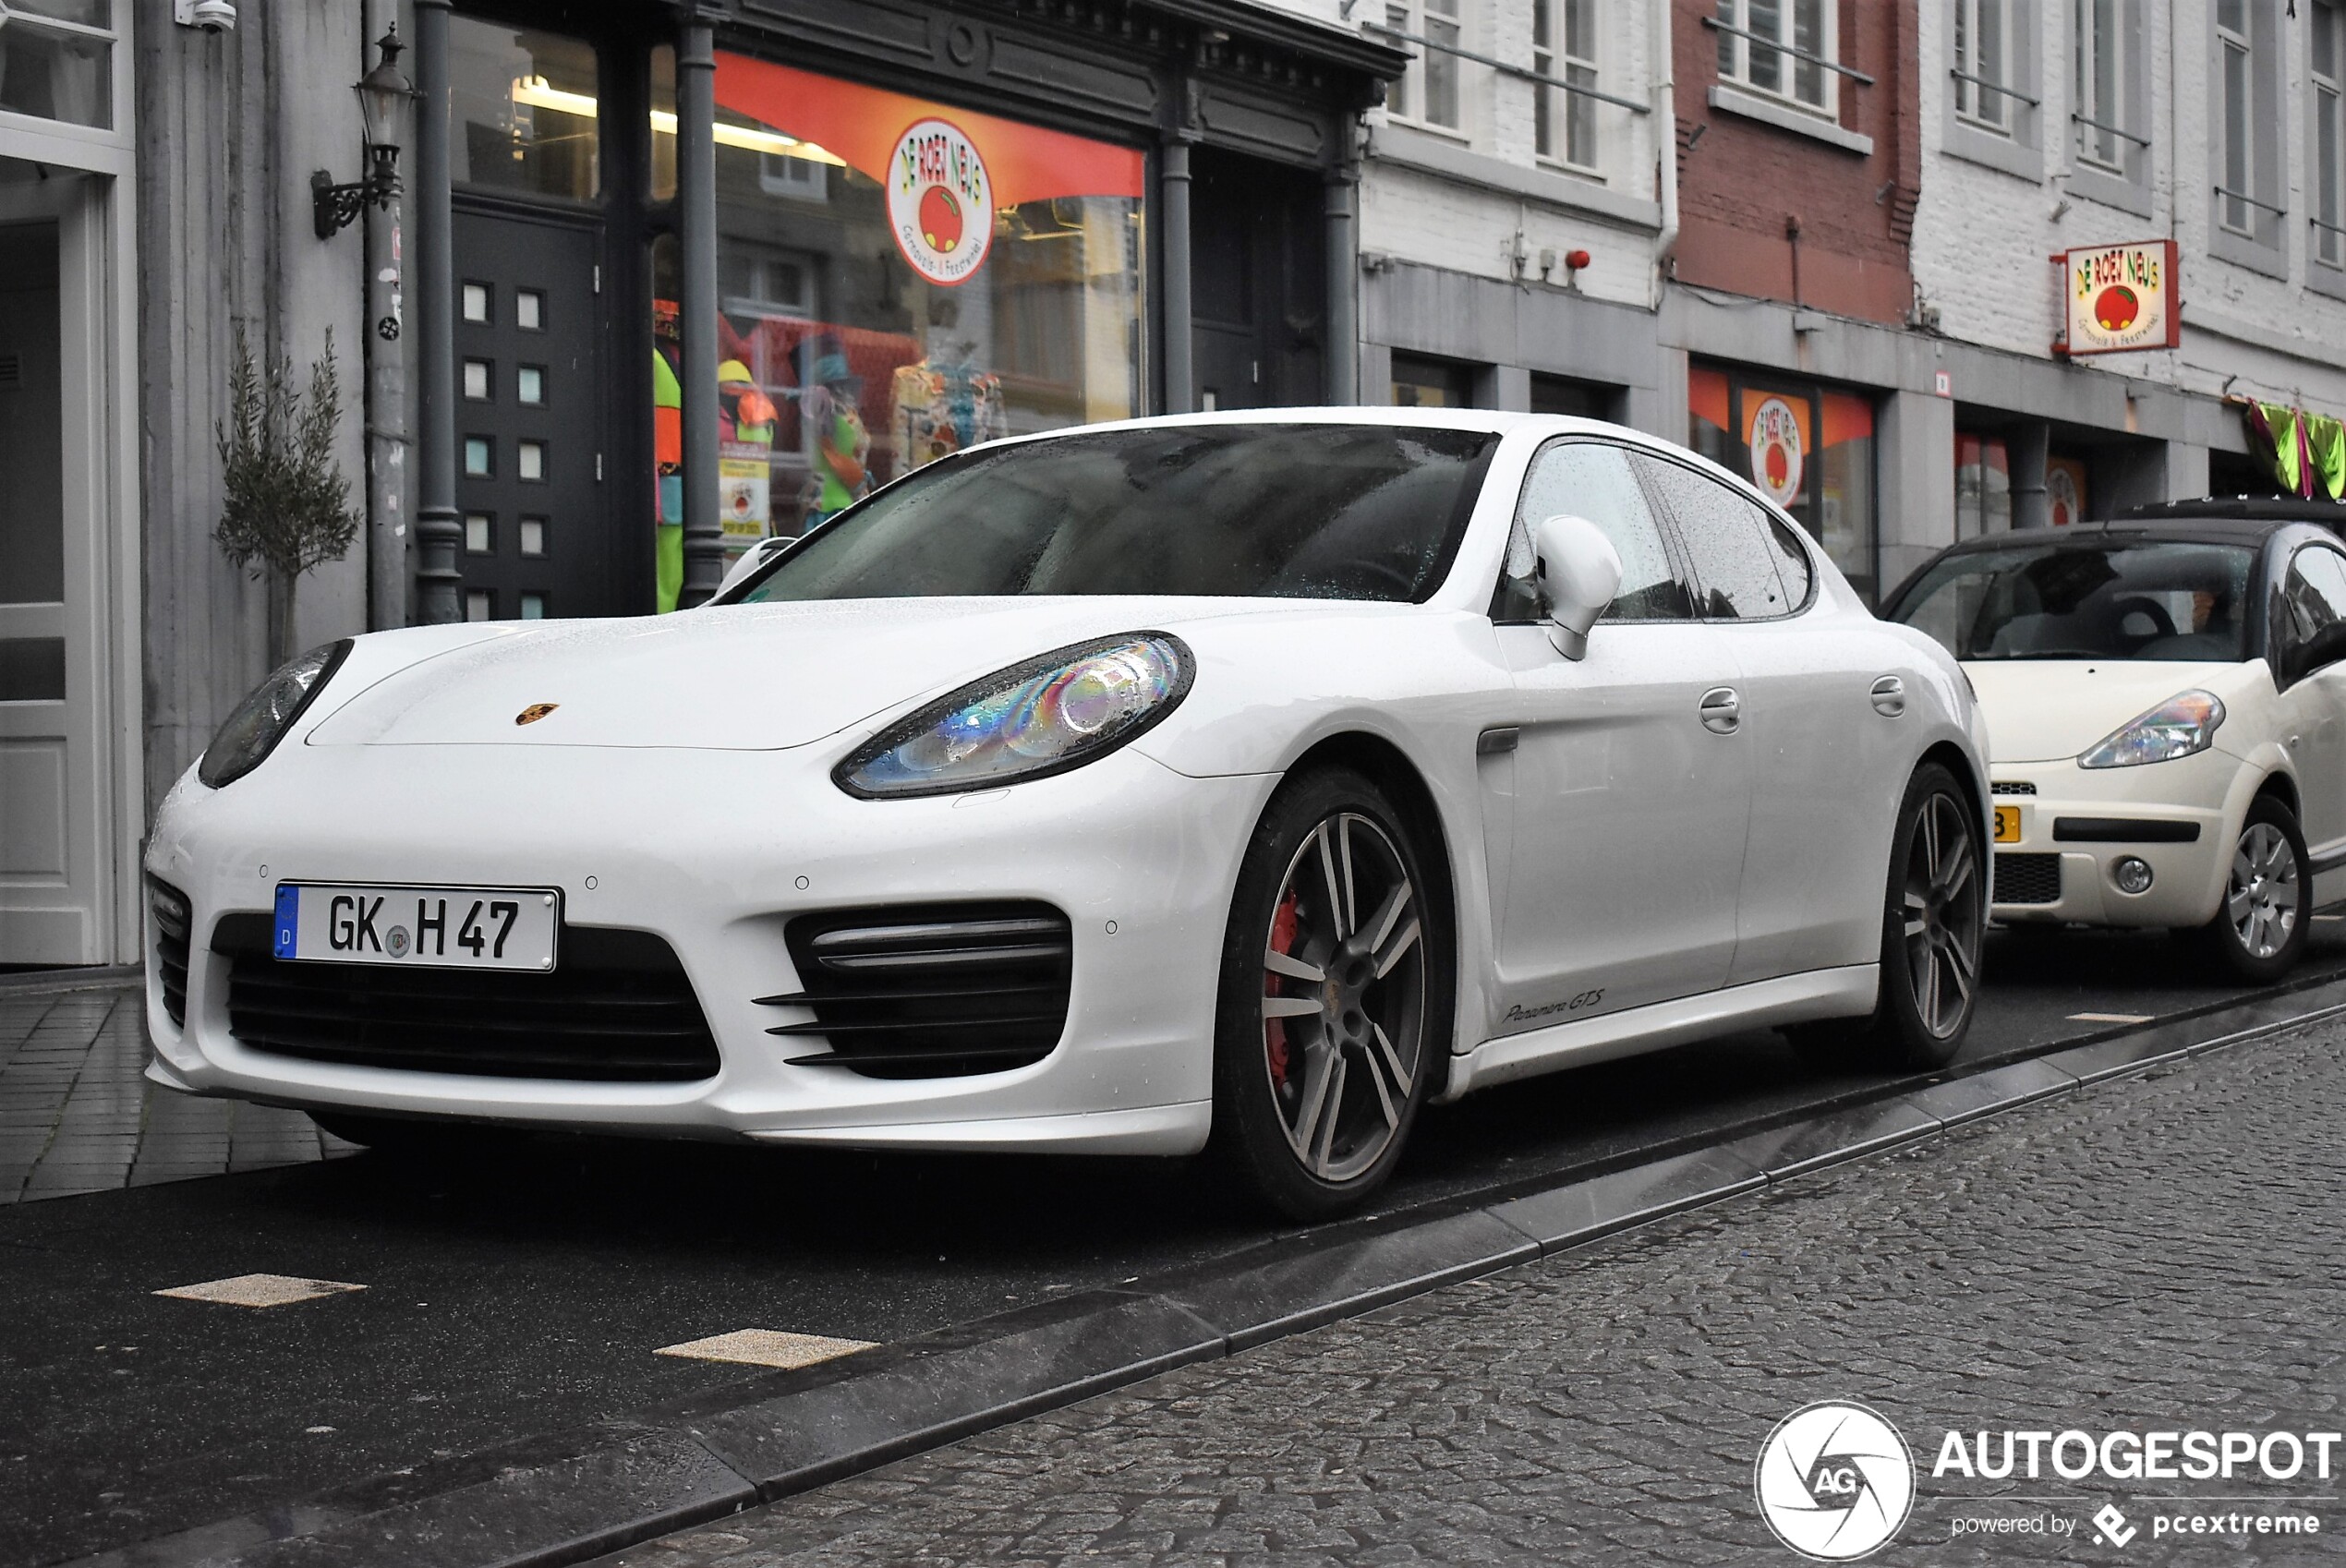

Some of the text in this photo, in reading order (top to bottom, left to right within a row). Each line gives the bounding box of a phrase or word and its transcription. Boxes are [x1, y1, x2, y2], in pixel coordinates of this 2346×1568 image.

[950, 141, 982, 207] NEUS
[946, 237, 984, 276] Feestwinkel
[2076, 259, 2091, 300] DE
[2127, 250, 2159, 294] NEUS
[282, 929, 291, 945] D
[329, 895, 519, 958] GK H 47
[1502, 988, 1605, 1024] Panamera GTS
